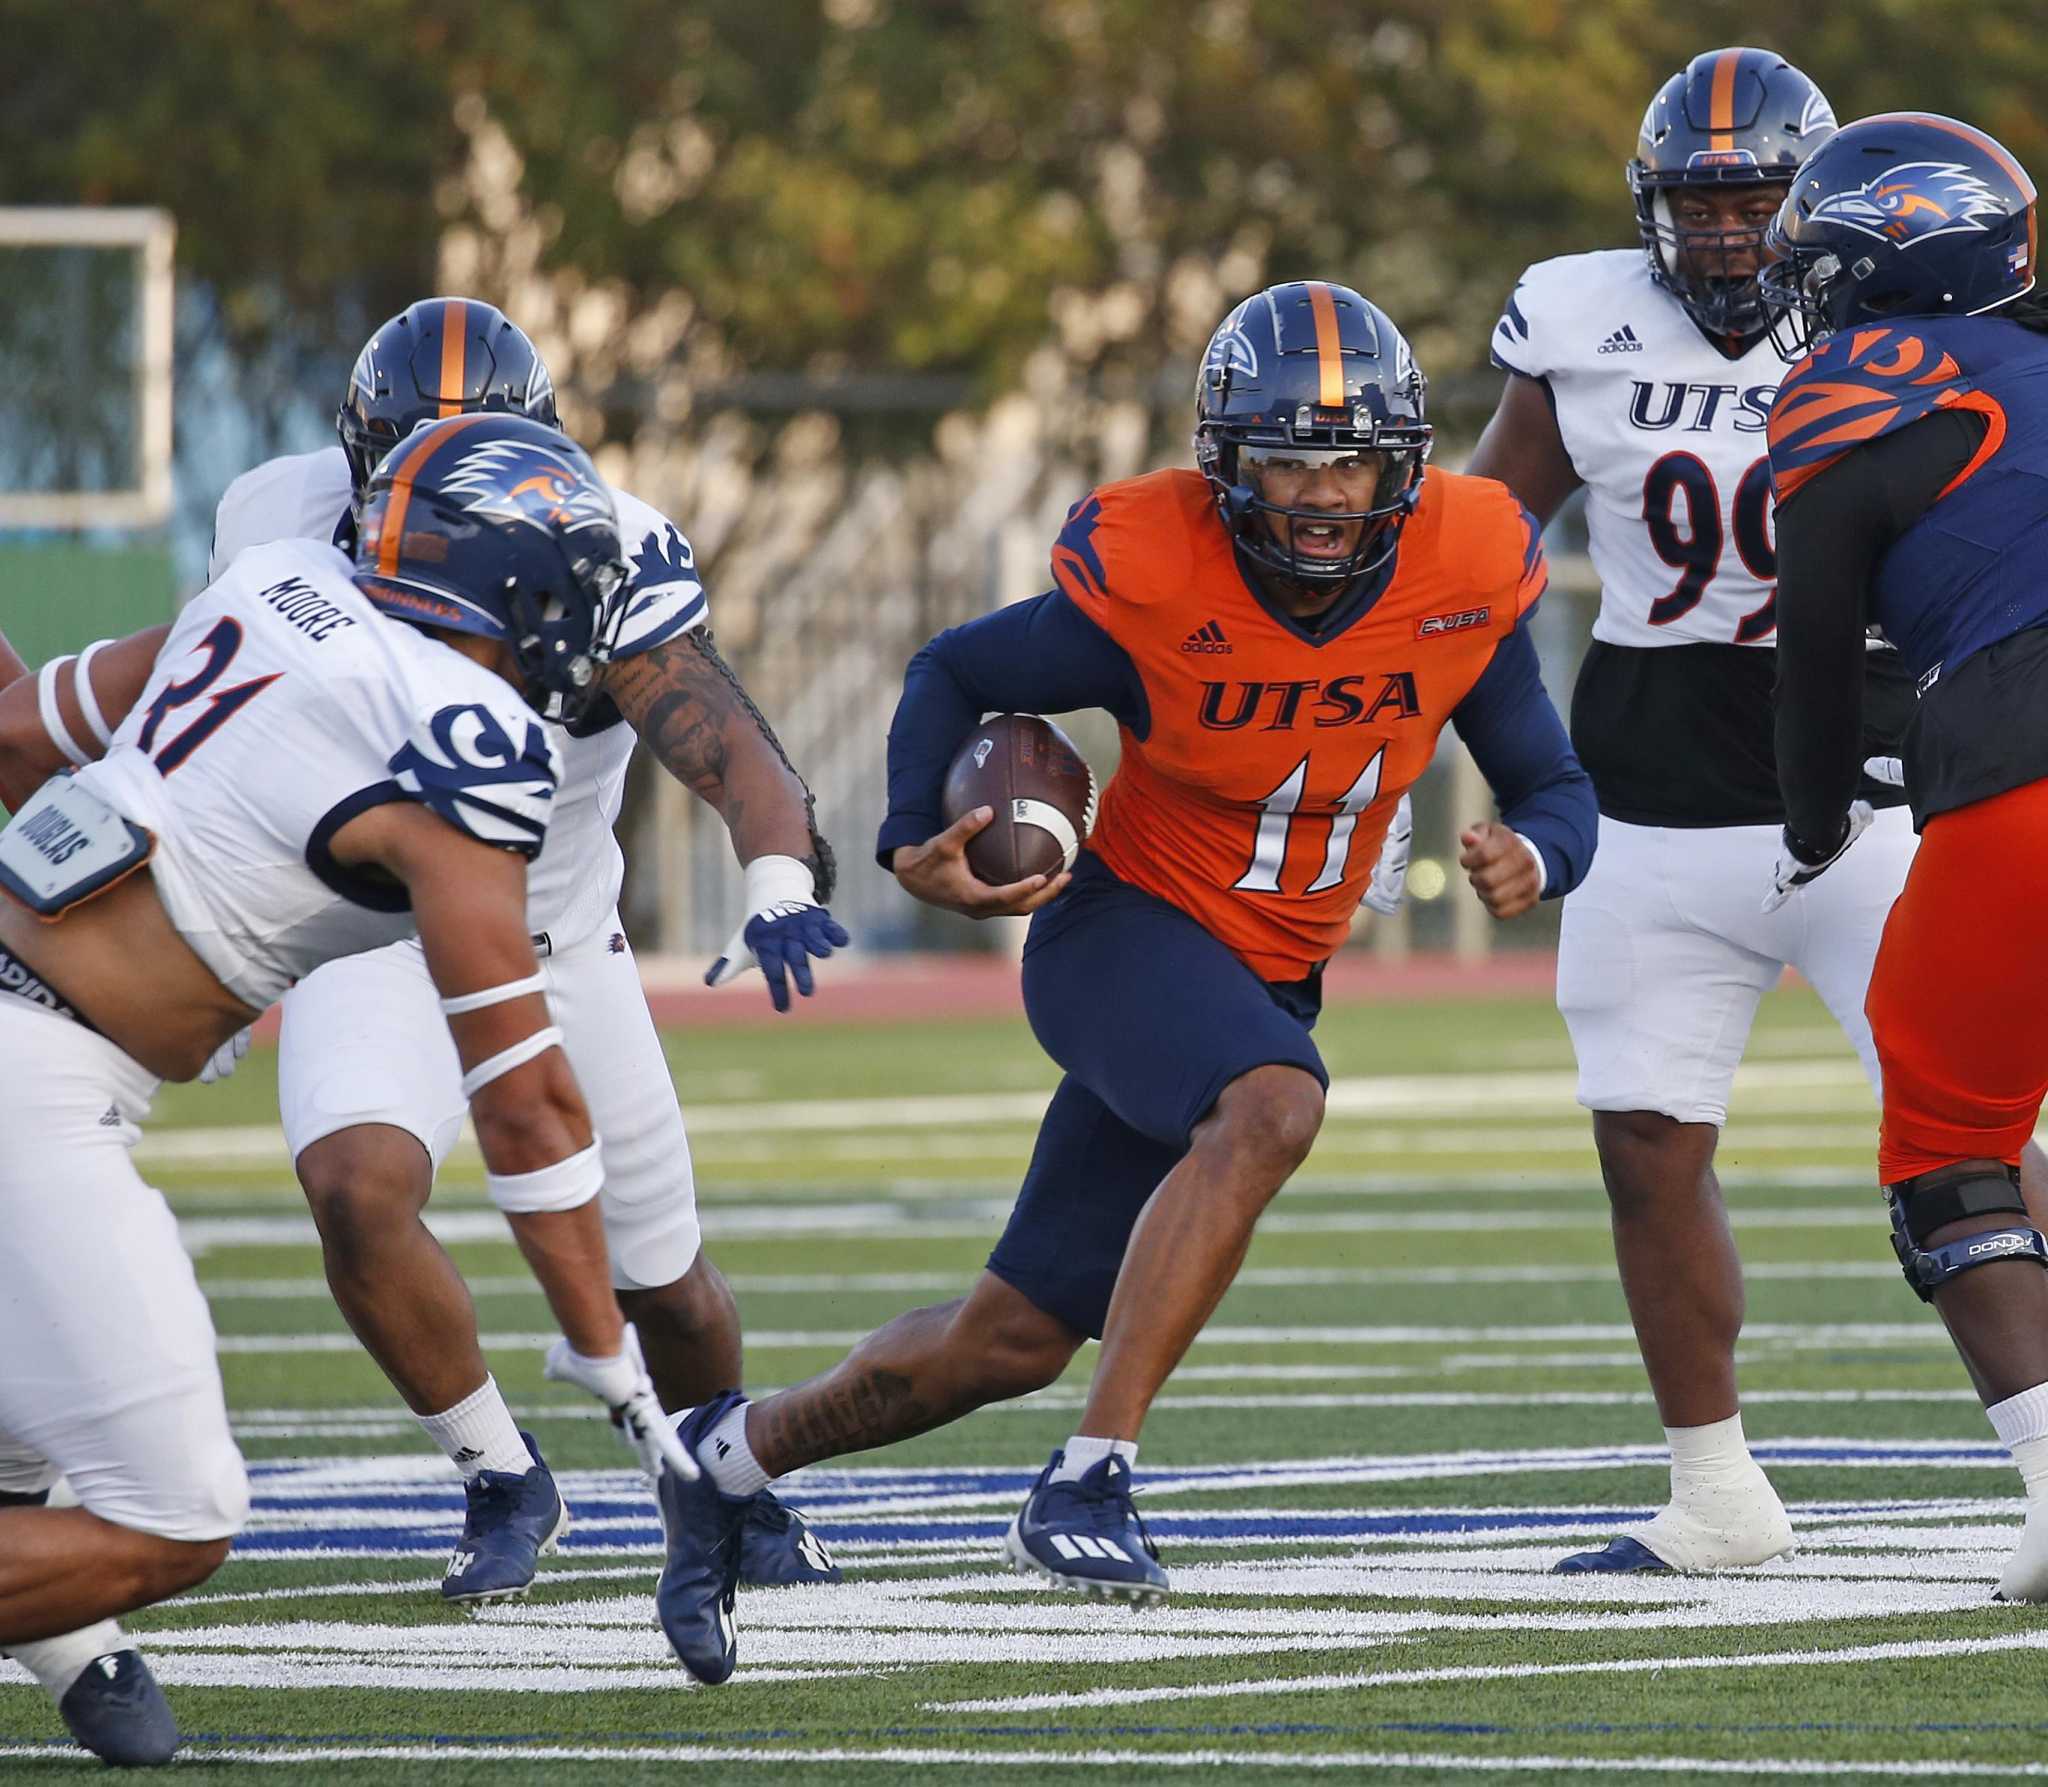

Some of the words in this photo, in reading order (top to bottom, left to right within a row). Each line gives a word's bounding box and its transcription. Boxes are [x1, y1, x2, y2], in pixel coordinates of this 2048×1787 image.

[1597, 340, 1643, 353] adidas
[1629, 380, 1779, 432] UTS
[259, 576, 357, 642] MOORE
[1181, 640, 1233, 654] adidas
[1200, 671, 1423, 732] UTSA
[1231, 741, 1389, 895] 11
